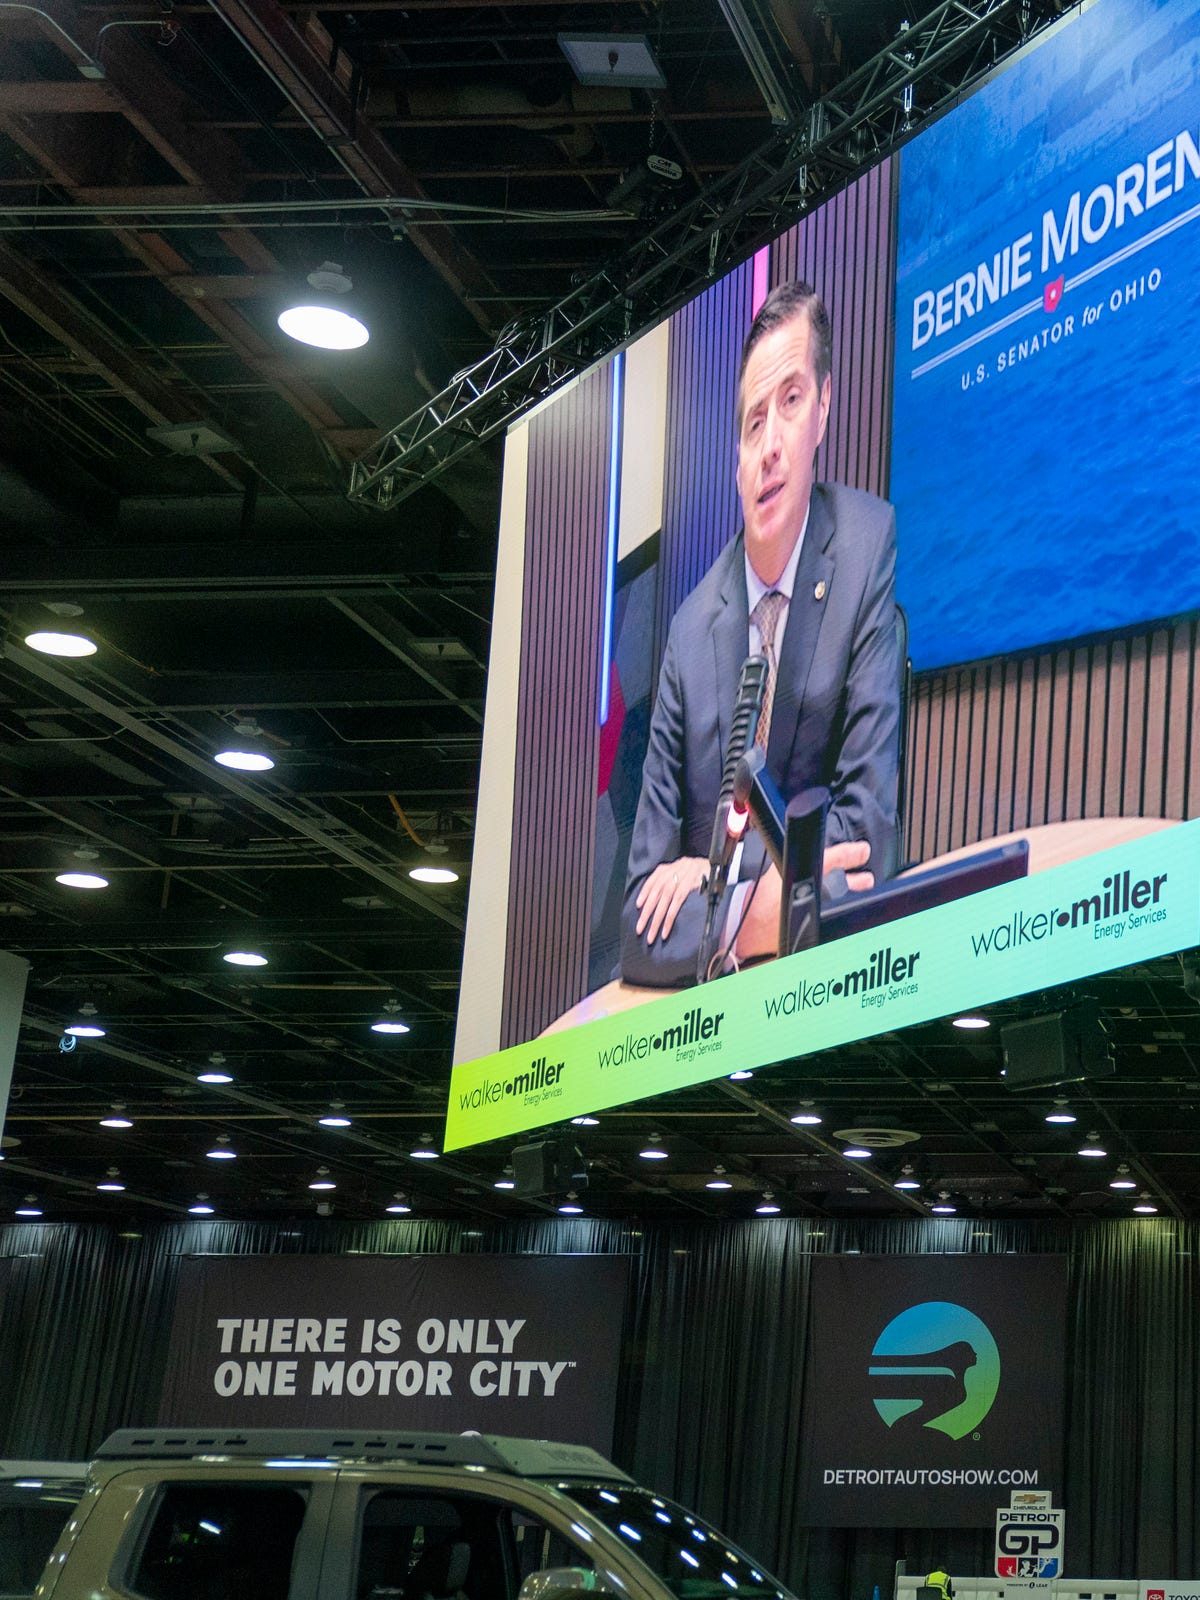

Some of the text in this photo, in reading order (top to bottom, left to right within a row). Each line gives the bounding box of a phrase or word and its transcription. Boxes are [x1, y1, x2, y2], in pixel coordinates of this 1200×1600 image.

[911, 232, 1033, 350] BERNIE
[961, 267, 1162, 390] U.S. SENATOR for OHIO
[1093, 907, 1168, 941] Energy Services
[860, 982, 919, 1009] Energy Services
[675, 1040, 723, 1064] Energy Services
[523, 1086, 563, 1107] Energy Services
[216, 1318, 526, 1354] THERE IS ONLY
[213, 1360, 298, 1397] ONE
[311, 1360, 453, 1397] MOTOR
[823, 1469, 1039, 1485] DETROITAUTOSHOW.COM
[999, 1512, 1061, 1522] DETROIT
[998, 1523, 1060, 1556] GP
